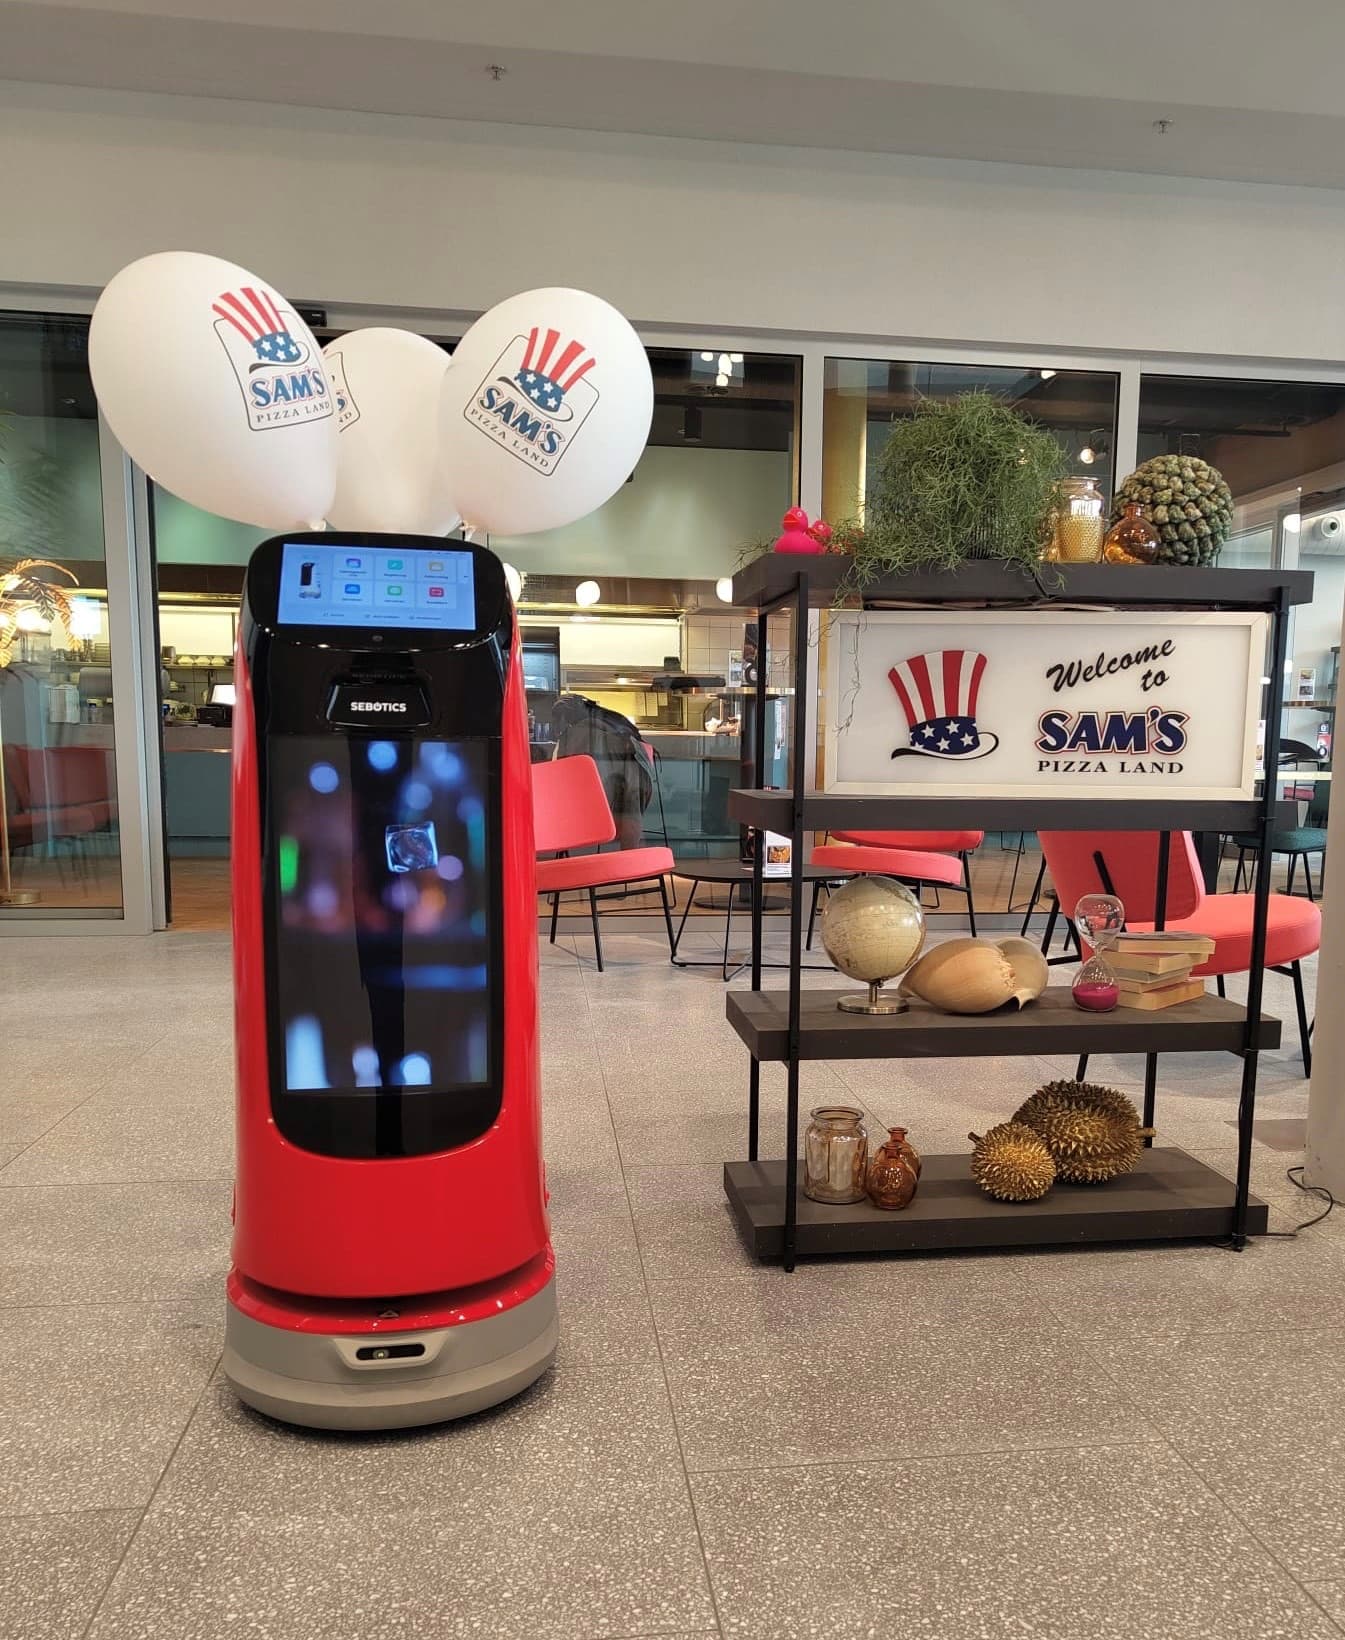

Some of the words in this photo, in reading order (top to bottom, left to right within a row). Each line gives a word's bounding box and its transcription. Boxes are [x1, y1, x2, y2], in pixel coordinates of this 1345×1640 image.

[250, 367, 327, 409] SAM'S
[256, 408, 300, 423] PIZZA
[305, 400, 330, 415] LAND
[478, 386, 564, 455] SAM'S
[470, 408, 507, 440] PIZZA
[512, 440, 549, 468] LAND
[1046, 639, 1176, 693] Welcome
[1140, 669, 1170, 692] to
[350, 701, 407, 713] SEBOTICS
[1035, 705, 1190, 756] SAM'S
[1037, 760, 1109, 773] PIZZA
[1119, 761, 1184, 774] LAND
